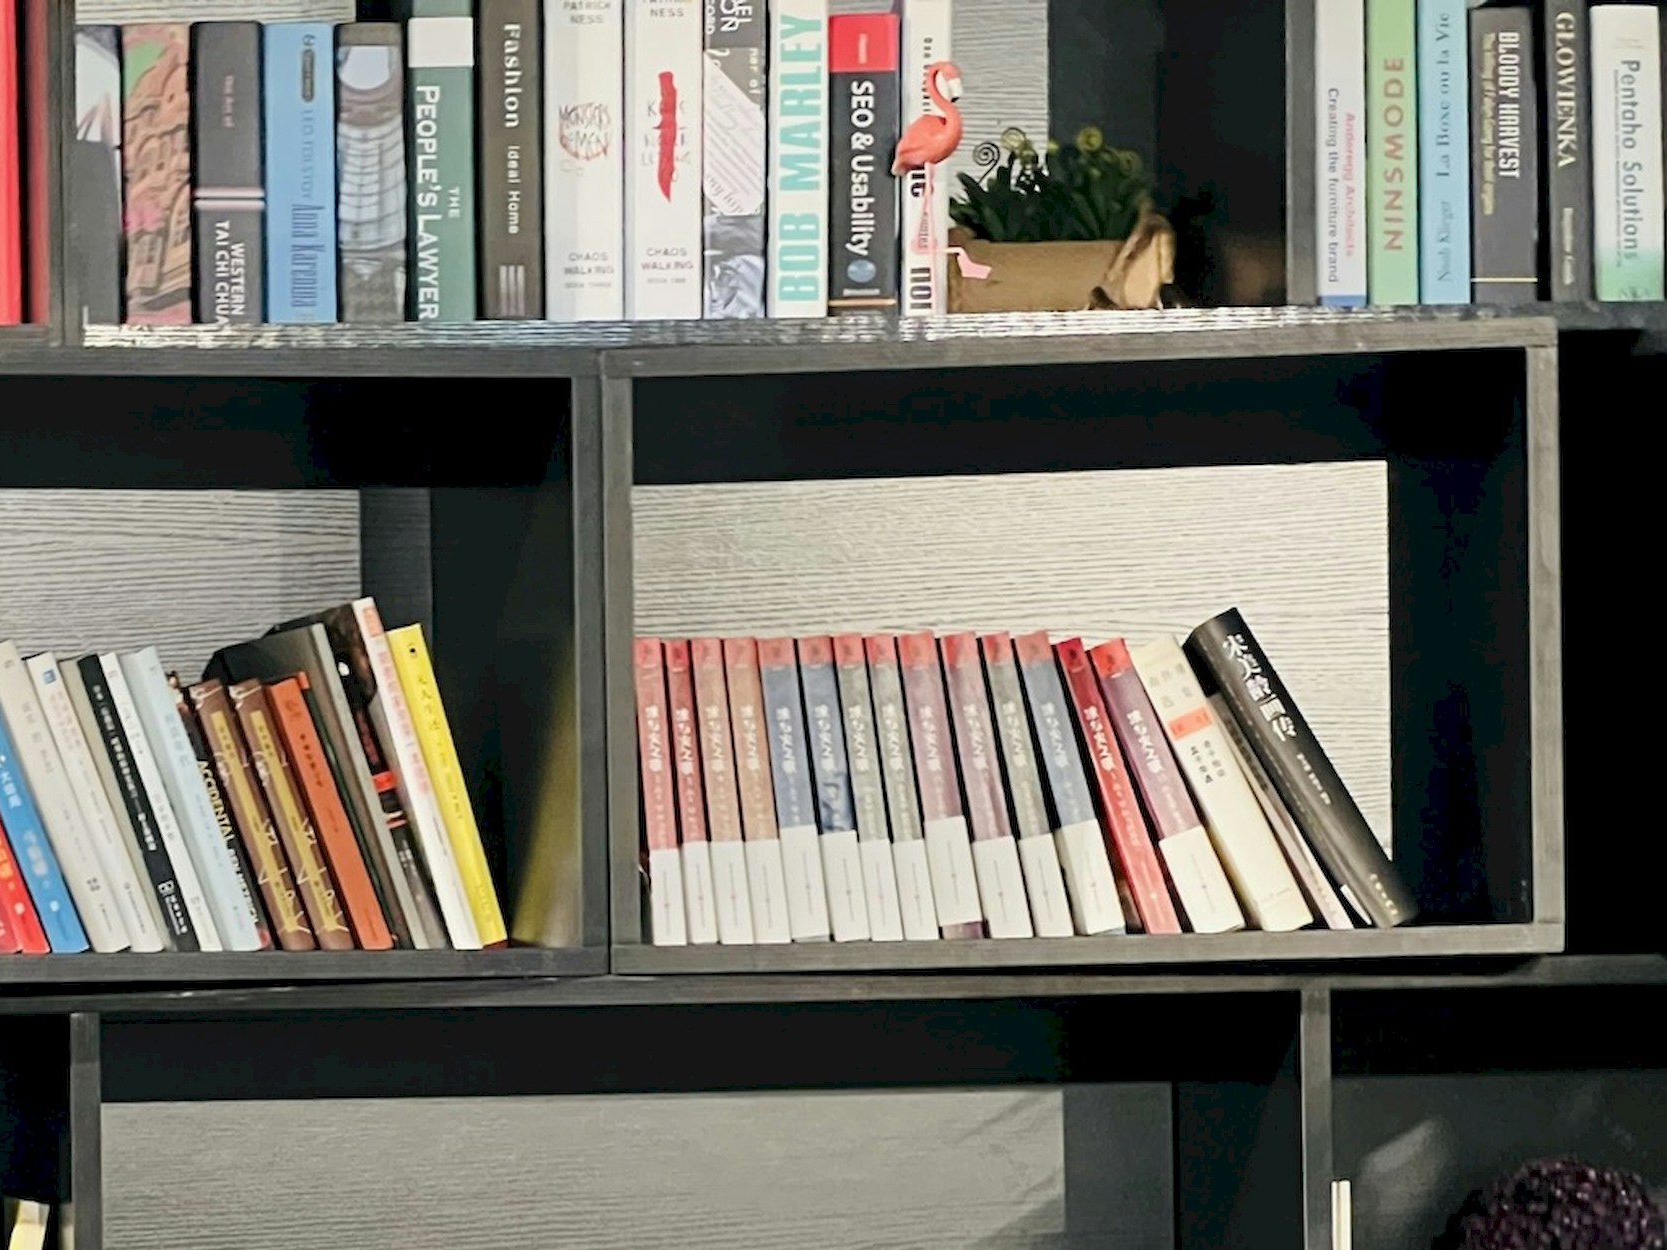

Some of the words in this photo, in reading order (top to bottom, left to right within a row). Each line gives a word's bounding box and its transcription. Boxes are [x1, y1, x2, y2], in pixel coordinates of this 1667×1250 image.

[570, 14, 605, 24] NESS
[649, 7, 685, 18] NESS
[1435, 12, 1450, 42] Vie
[503, 23, 523, 129] Fashion
[1437, 48, 1450, 65] la
[1498, 31, 1520, 98] BLOODY
[779, 14, 823, 191] MARLEY
[850, 80, 875, 128] SEO
[1554, 12, 1577, 168] GLOWIENKA
[1621, 60, 1641, 149] Pentaho
[1327, 87, 1340, 149] Creating
[1498, 103, 1521, 178] HARVEST
[415, 85, 443, 208] PEOPLE'S
[507, 145, 521, 184] Ideal
[850, 134, 875, 150] &
[1327, 154, 1340, 175] the
[1435, 154, 1451, 177] La
[447, 186, 461, 219] THE
[507, 190, 521, 235] Home
[844, 155, 876, 257] Usability
[1327, 177, 1340, 237] furniture
[1622, 161, 1645, 260] Solutions
[214, 220, 230, 247] TAI
[568, 250, 609, 262] CHAOS
[646, 246, 688, 257] CHAOS
[214, 251, 231, 278] CHI
[417, 213, 443, 320] LAWYER
[563, 265, 615, 275] WALKING
[641, 260, 694, 271] WALKING
[778, 213, 821, 301] BOB
[1327, 240, 1340, 283] brand
[230, 243, 246, 317] WESTERN
[197, 760, 236, 852] ACCIDENTAL
